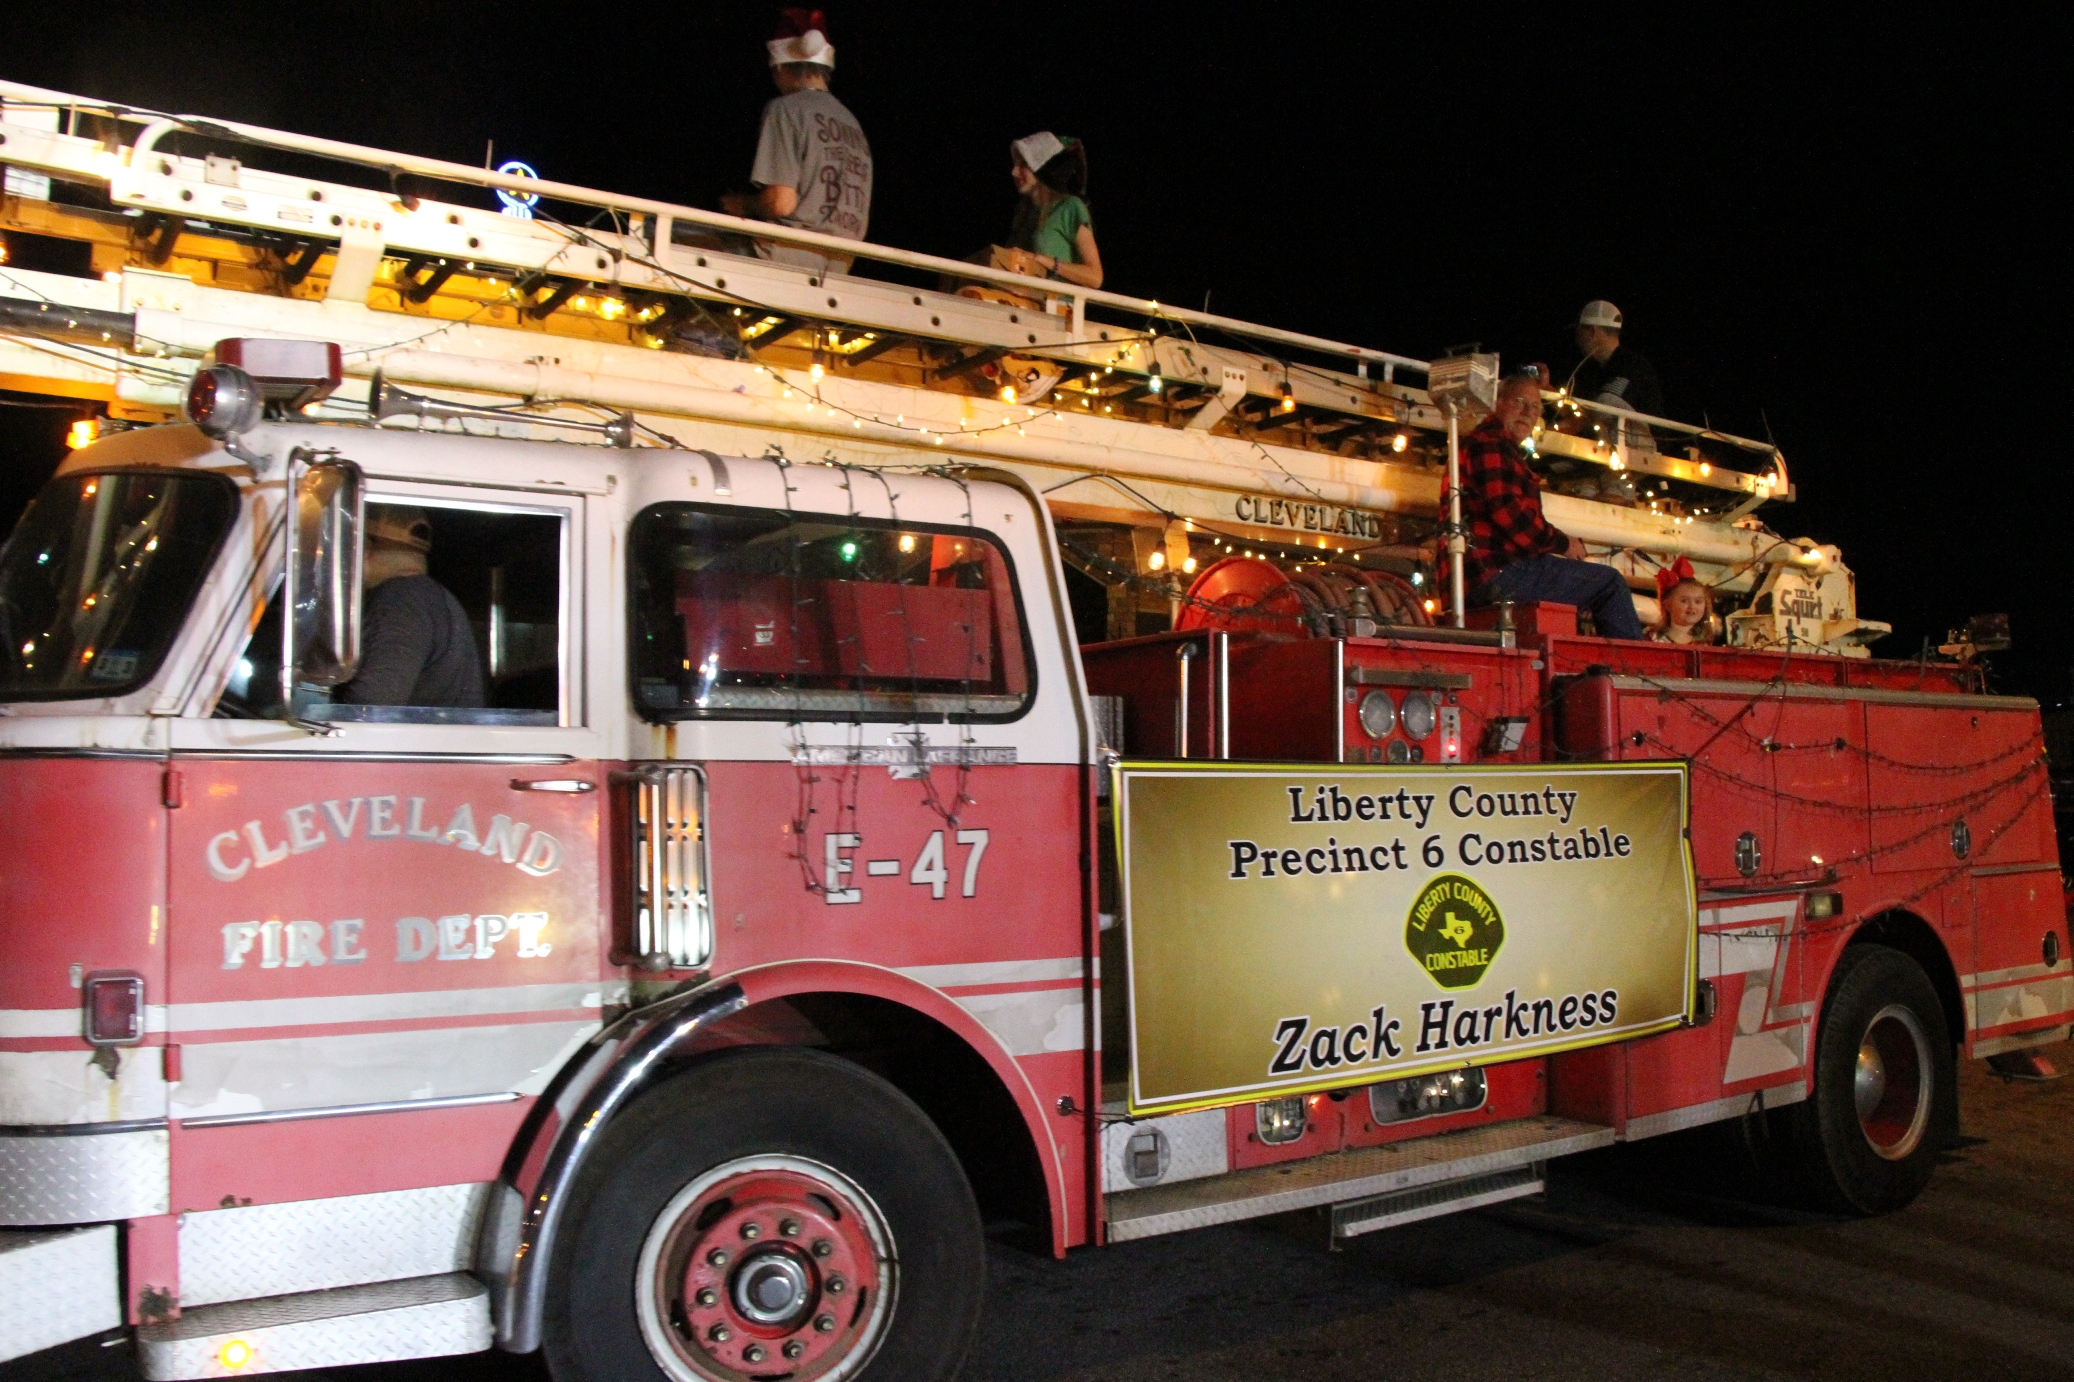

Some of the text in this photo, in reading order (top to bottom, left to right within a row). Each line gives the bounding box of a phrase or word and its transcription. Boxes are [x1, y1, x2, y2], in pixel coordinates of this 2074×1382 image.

[1235, 495, 1379, 538] CLEVELAND
[1288, 785, 1577, 829] Liberty County
[206, 795, 563, 882] CLEVELAND
[1230, 827, 1632, 878] Precinct 6 Constable
[825, 829, 989, 904] E-47
[1412, 882, 1497, 931] LIBERTY COUNTY
[1454, 926, 1465, 935] 6
[221, 918, 367, 970] FIRE
[1426, 949, 1489, 971] CONSTABLE
[1271, 990, 1618, 1073] Zack Harkness
